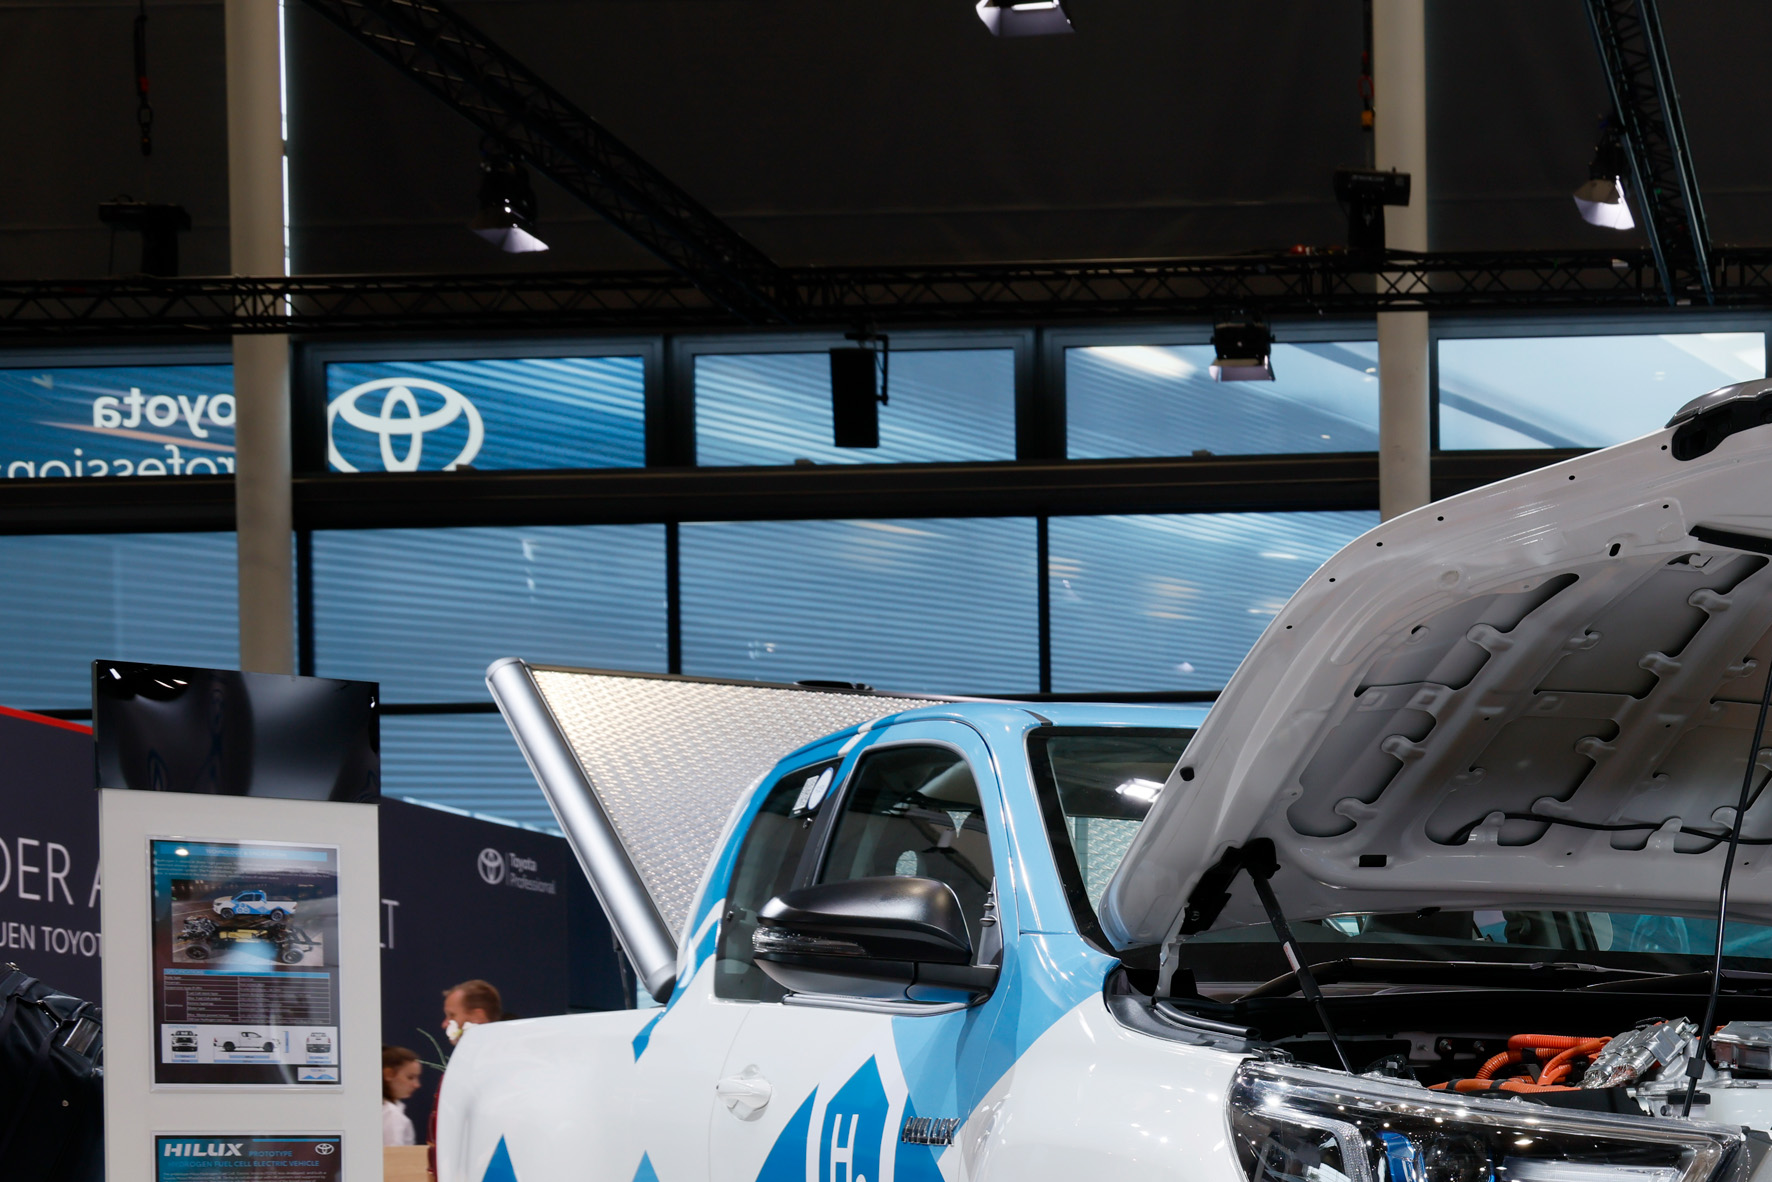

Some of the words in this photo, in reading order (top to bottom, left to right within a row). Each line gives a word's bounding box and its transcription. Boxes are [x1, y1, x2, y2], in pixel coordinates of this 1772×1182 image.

[509, 852, 537, 872] Toyota
[510, 873, 556, 894] Professional
[902, 1115, 961, 1147] HILUX
[163, 1143, 244, 1157] HILUX
[248, 1150, 293, 1158] PROTOTYPE
[168, 1160, 213, 1168] HYDROGEN
[214, 1160, 233, 1168] FUEL
[235, 1160, 252, 1168] CELL
[253, 1160, 288, 1168] ELECTRIC
